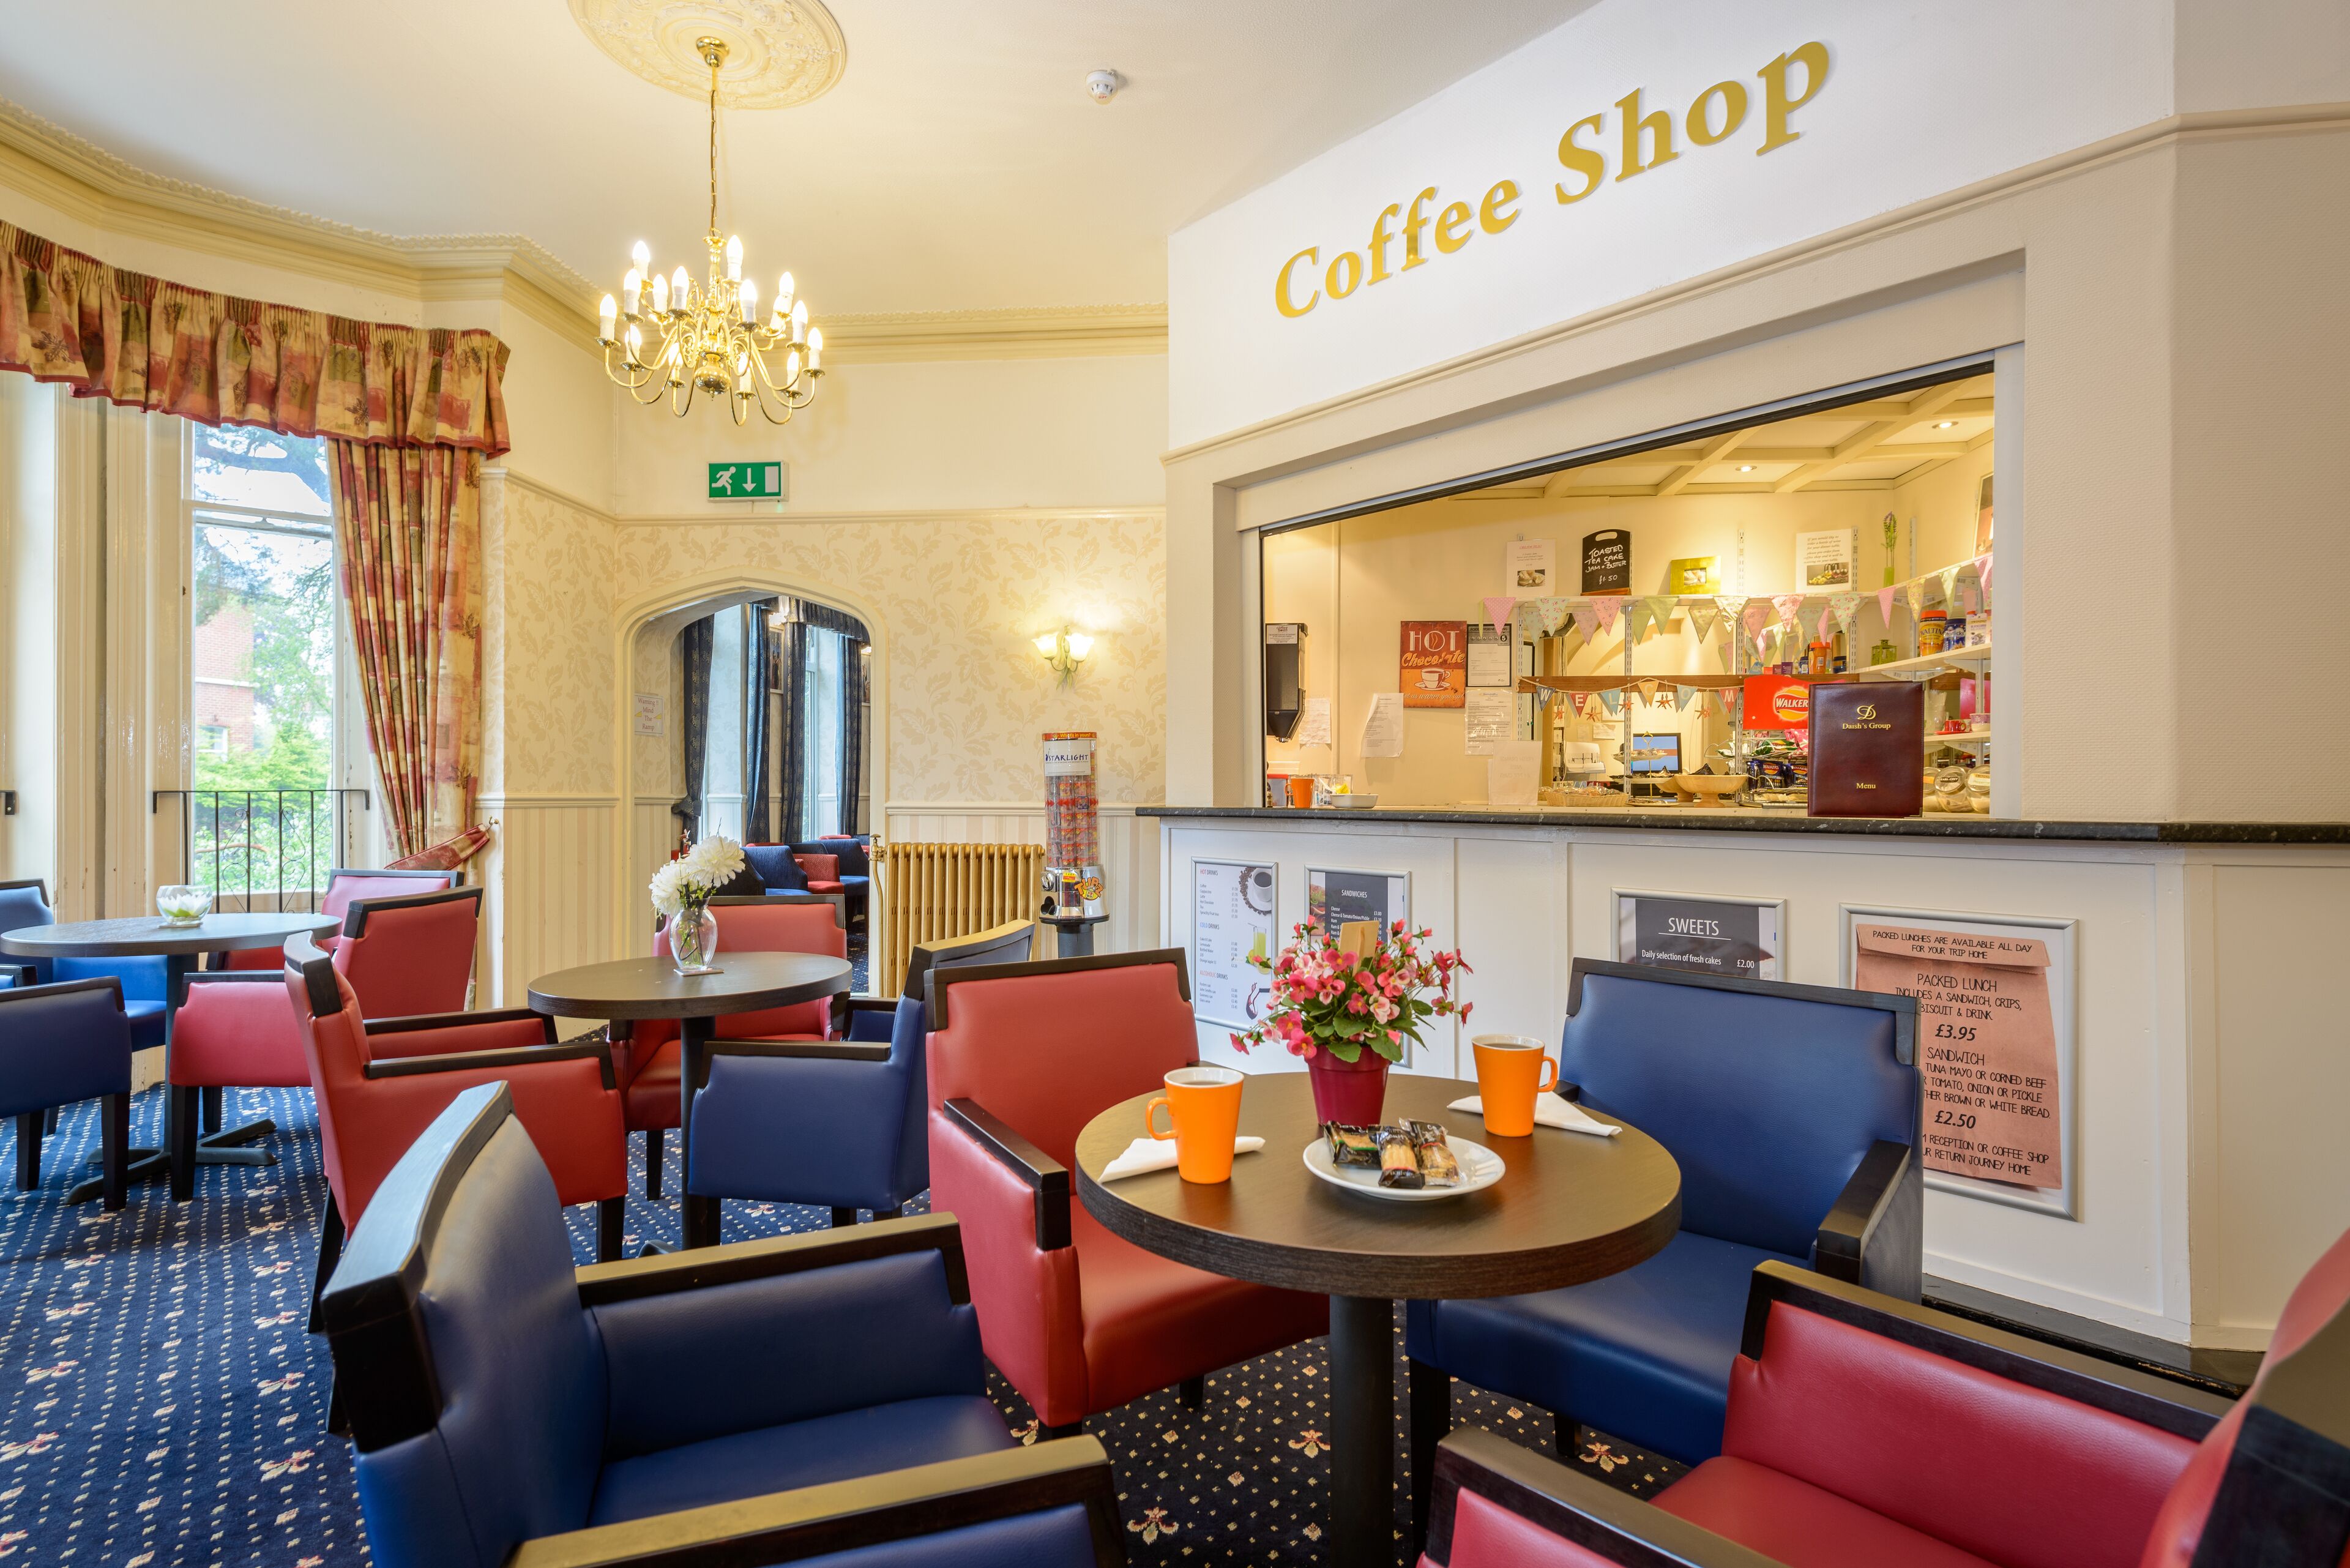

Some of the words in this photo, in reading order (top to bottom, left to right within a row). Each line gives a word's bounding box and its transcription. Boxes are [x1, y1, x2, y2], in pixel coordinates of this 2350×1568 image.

[1275, 179, 1520, 318] Coffee
[1554, 41, 1830, 204] Shop
[1589, 544, 1623, 559] TOASTED
[1604, 553, 1624, 562] CAKE
[1605, 560, 1627, 569] BUTTER
[1598, 574, 1617, 585] £1.50
[1409, 630, 1460, 651] HOT
[1401, 650, 1466, 667] Chocolate
[1776, 698, 1809, 707] WALKER
[1341, 889, 1367, 898] SANDWICHES
[1668, 917, 1719, 936] SWEETS
[1873, 930, 1899, 939] PACKED
[1901, 933, 1931, 943] LUNCHES
[1934, 936, 1948, 945] ARE
[1952, 938, 1995, 949] AVAILABLE
[1641, 949, 1655, 960] Daily
[1656, 951, 1681, 961] selection
[1689, 954, 1704, 963] fresh
[1705, 955, 1721, 965] cakes
[1737, 959, 1755, 968] £2.00
[1928, 946, 1945, 955] YOUR
[1949, 948, 1966, 957] TRIP
[1968, 950, 1988, 960] HOME
[1917, 973, 1958, 988] PACKED
[1963, 978, 1997, 993] LUNCH
[1895, 987, 1932, 1000] INCLUDES
[1936, 991, 1942, 1001] A
[1945, 992, 1991, 1007] SANDWICH,
[1995, 998, 2022, 1011] CRIPS,
[1920, 1003, 1953, 1015] BISCUIT
[1956, 1007, 1963, 1017] &
[1966, 1009, 1993, 1020] DRINK
[1934, 1024, 1977, 1041] £3.95
[1927, 1047, 1985, 1066] SANDWICH
[1925, 1062, 1946, 1074] TUNA
[1950, 1066, 1972, 1078] MAYO
[1975, 1070, 1986, 1081] OR
[1990, 1072, 2022, 1085] CORNED
[2026, 1077, 2046, 1089] BEEF
[1930, 1077, 1964, 1092] TOMATO,
[1968, 1083, 1994, 1096] ONION
[1997, 1087, 2009, 1097] OR
[2012, 1089, 2042, 1103] PICKLE
[1944, 1094, 1971, 1106] BROWN
[1975, 1097, 1986, 1108] OR
[1989, 1099, 2017, 1113] WHITE
[2021, 1105, 2051, 1119] BREAD.
[1934, 1110, 1976, 1129] £2.50
[1929, 1134, 1974, 1151] RECEPTION
[1977, 1143, 1988, 1153] OR
[1992, 1145, 2023, 1160] COFFEE
[2027, 1151, 2049, 1163] SHOP
[1934, 1149, 1965, 1163] RETURN
[1968, 1155, 2005, 1170] JOURNEY
[2009, 1164, 2031, 1175] HOME
